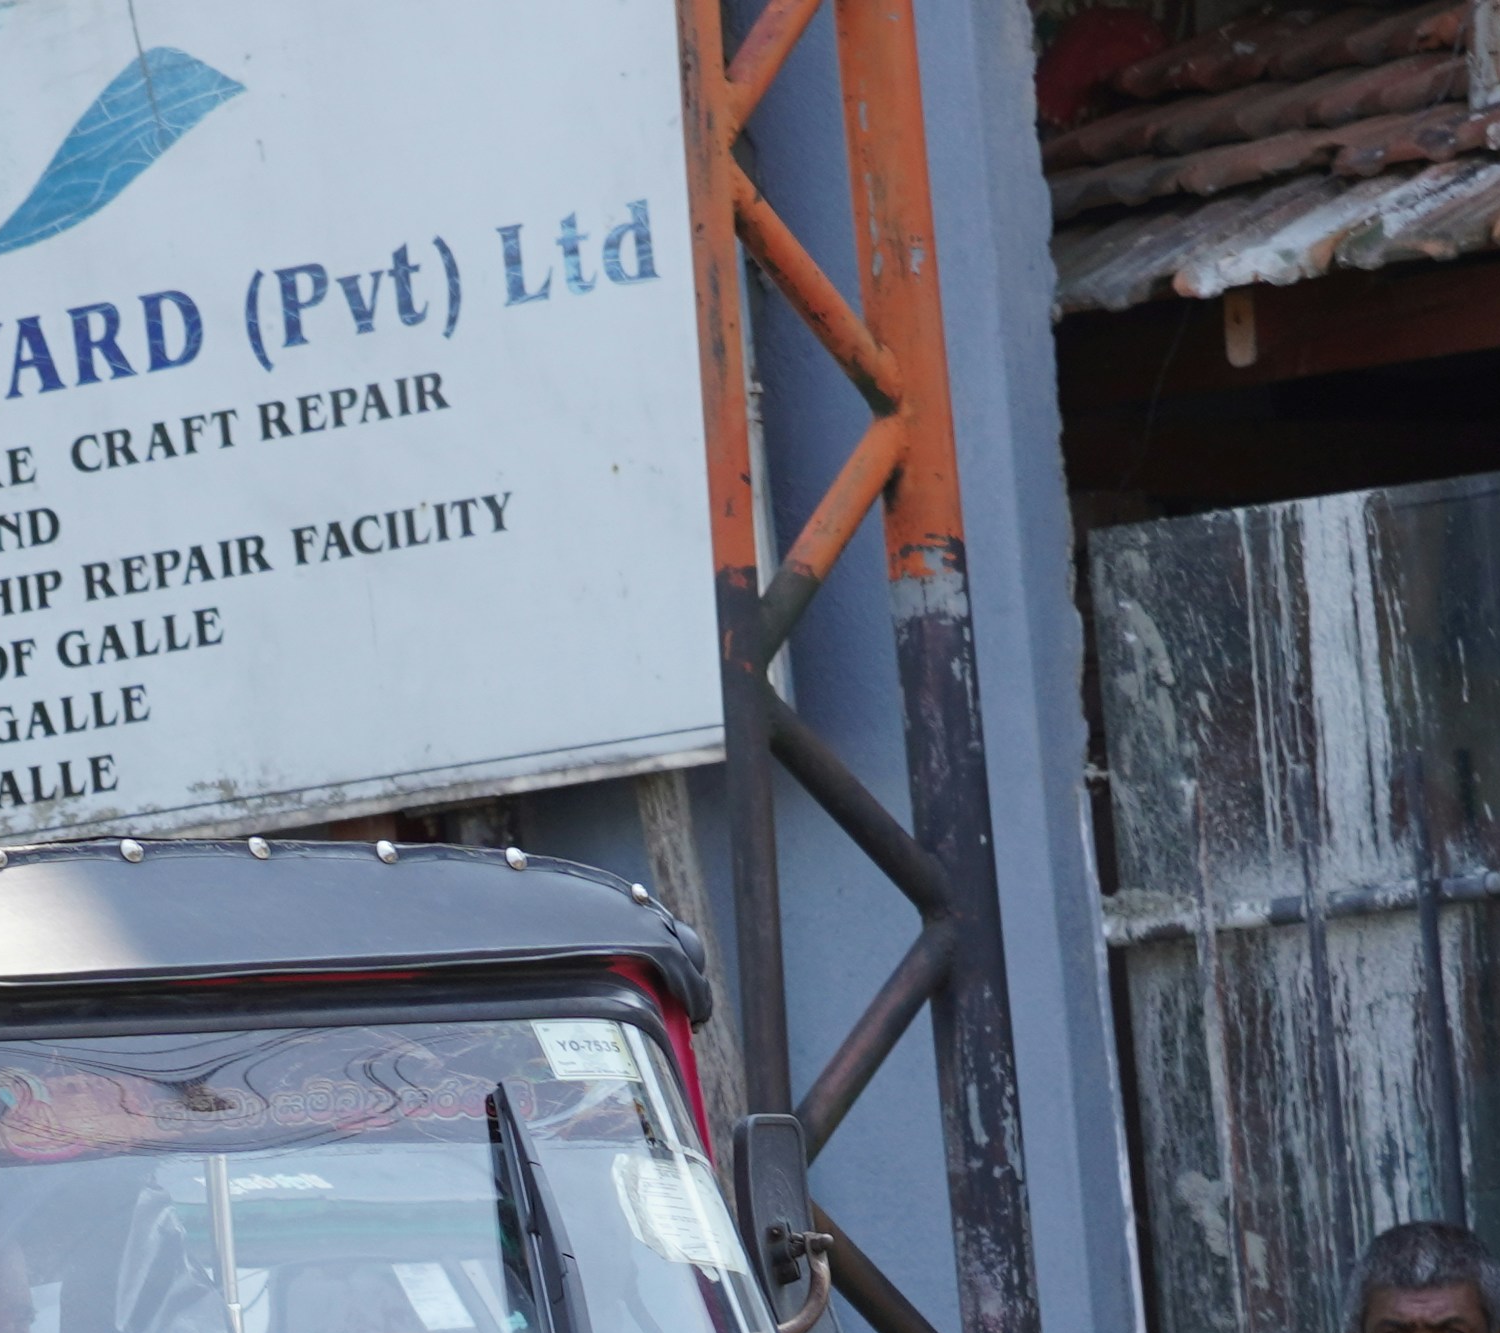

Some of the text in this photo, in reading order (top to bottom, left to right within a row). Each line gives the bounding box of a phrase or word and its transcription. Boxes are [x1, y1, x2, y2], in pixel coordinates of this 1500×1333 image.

[245, 236, 462, 373] (Pvt)
[497, 198, 658, 304] Ltd
[70, 407, 239, 474] CRAFT
[257, 373, 452, 442] REPAIR
[81, 533, 275, 603] REPAIR
[290, 492, 512, 566] FACILITY
[56, 608, 224, 669] GALLE
[555, 1038, 622, 1054] YO-7535
